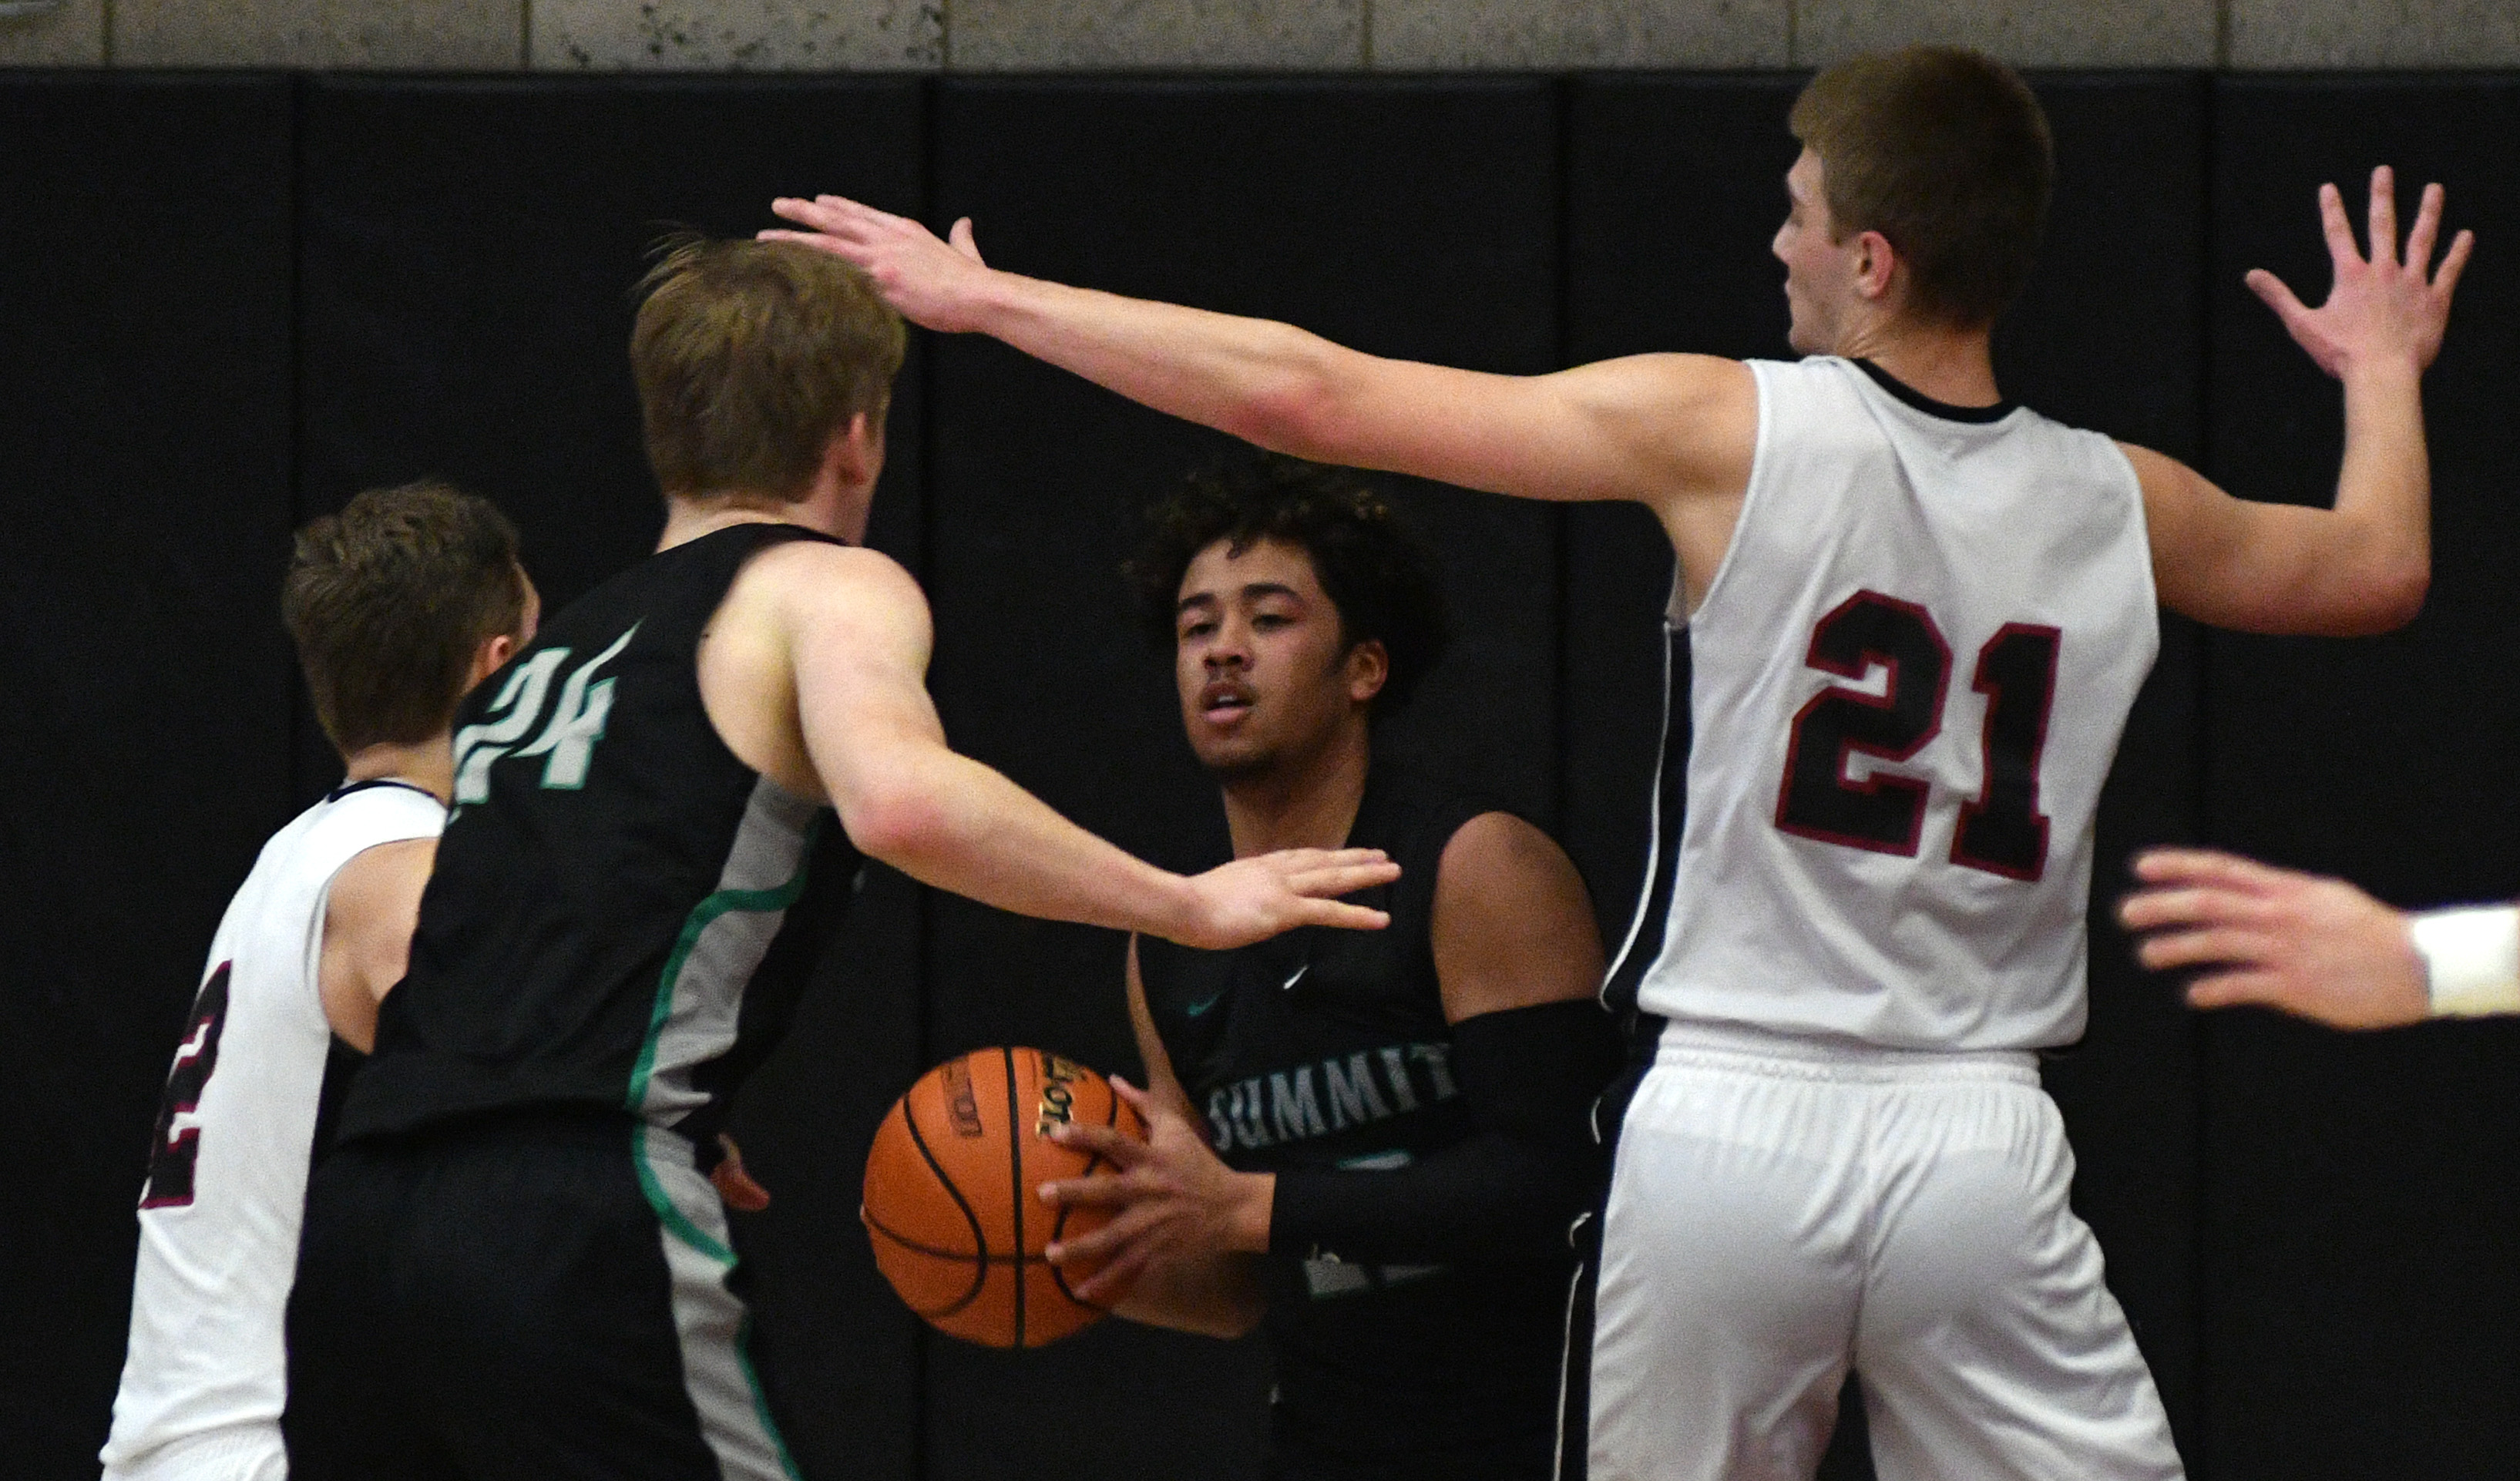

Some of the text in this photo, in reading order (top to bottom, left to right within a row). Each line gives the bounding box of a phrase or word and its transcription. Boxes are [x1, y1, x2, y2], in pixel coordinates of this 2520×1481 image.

[449, 615, 646, 826] 24
[1775, 589, 2061, 882] 21
[139, 959, 232, 1210] 2
[1208, 1042, 1459, 1151] SUMMIT
